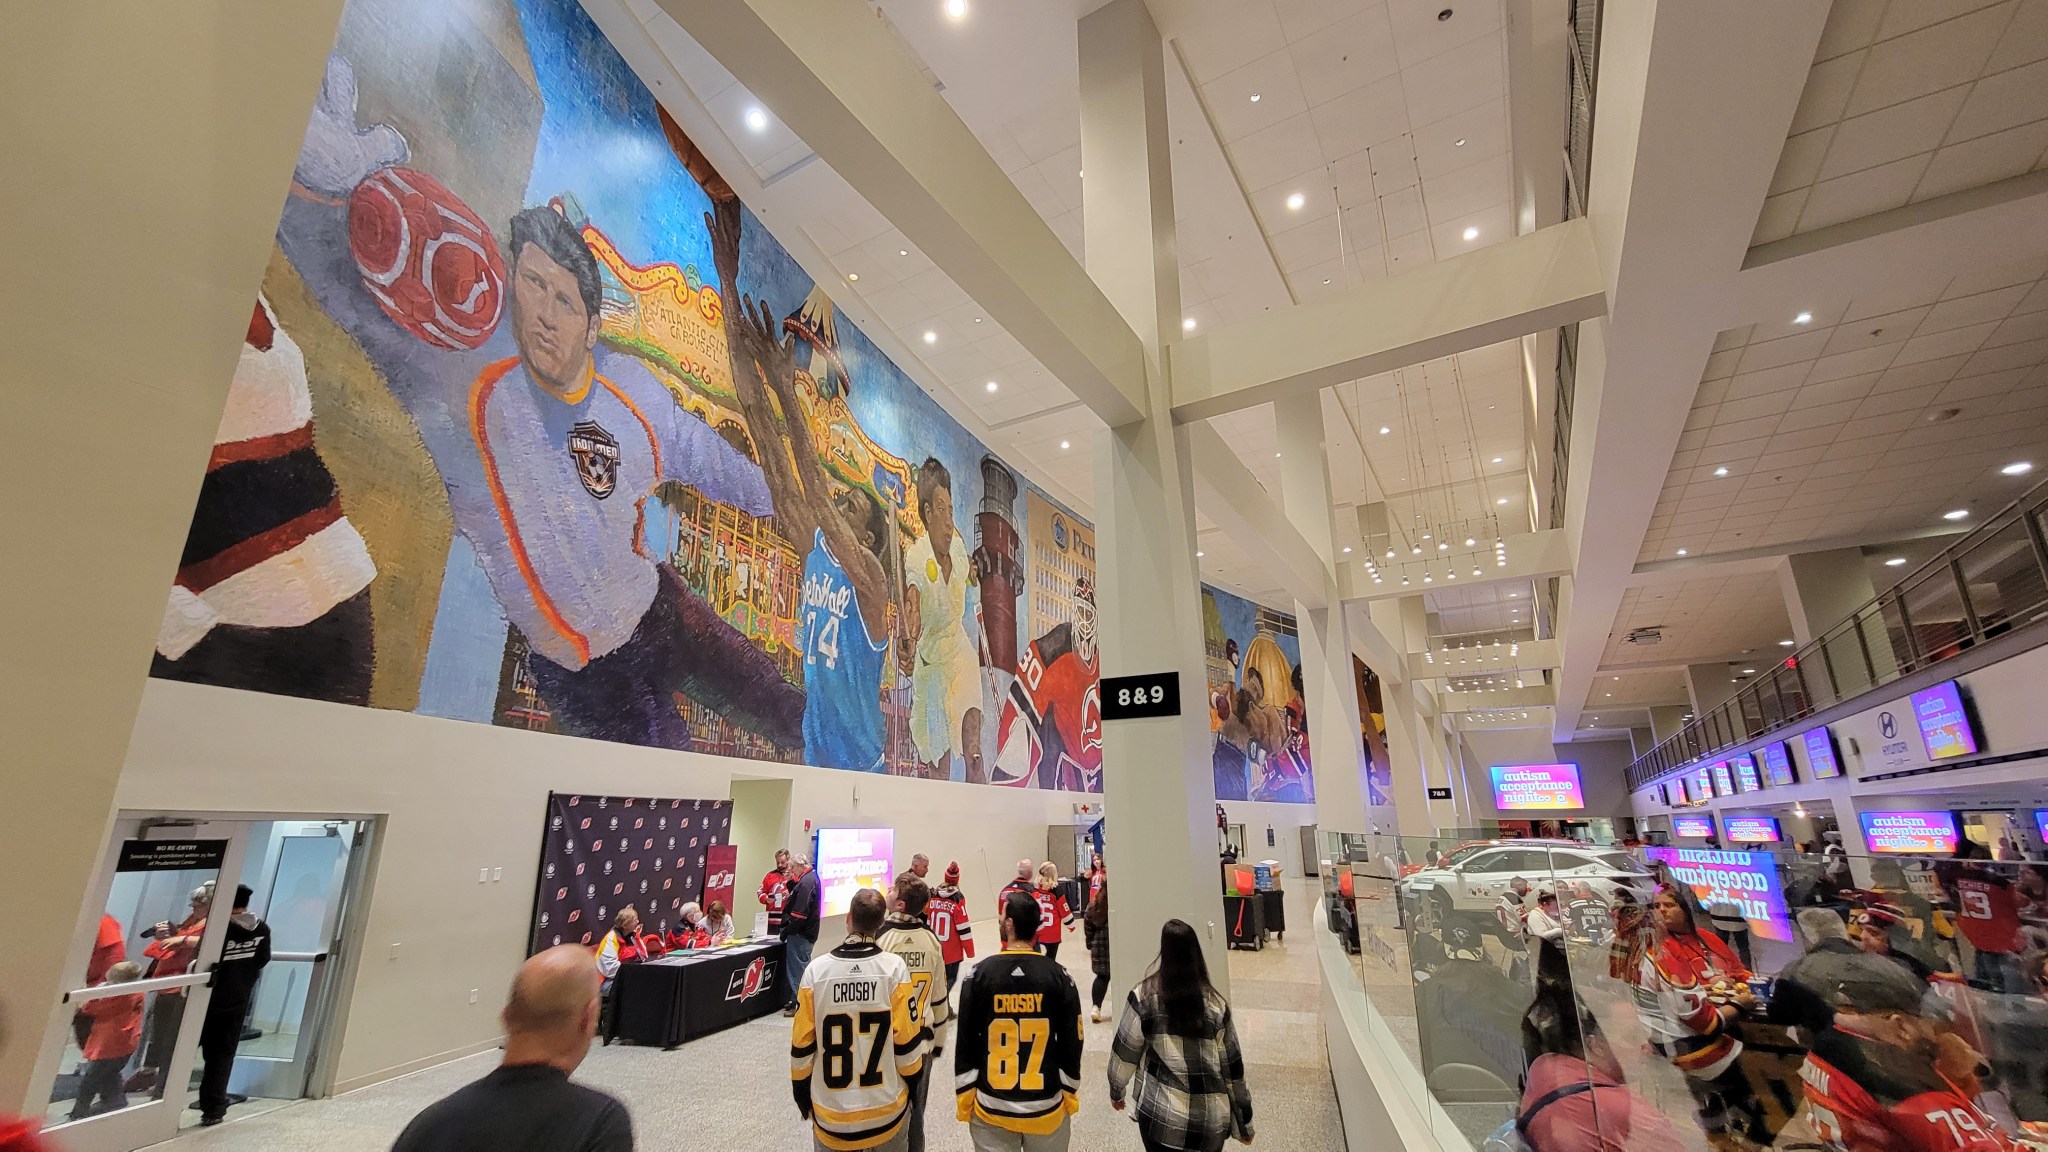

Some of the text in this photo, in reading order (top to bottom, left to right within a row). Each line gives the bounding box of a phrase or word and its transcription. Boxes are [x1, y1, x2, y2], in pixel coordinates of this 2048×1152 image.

[660, 308, 728, 360] ATLANTIC CIT
[670, 325, 719, 364] CAROUSEL
[1118, 685, 1164, 706] 8&9
[1503, 770, 1551, 782] autism
[1499, 780, 1574, 794] acceptance
[1503, 791, 1541, 805] night
[1873, 816, 1926, 827] autism
[1869, 825, 1951, 839] acceptance
[1875, 836, 1913, 849] night
[833, 981, 877, 1003] CROSBY
[993, 993, 1044, 1013] CROSBY
[822, 1009, 892, 1090] 87
[987, 1017, 1050, 1090] 87
[1924, 1107, 1990, 1148] 79
